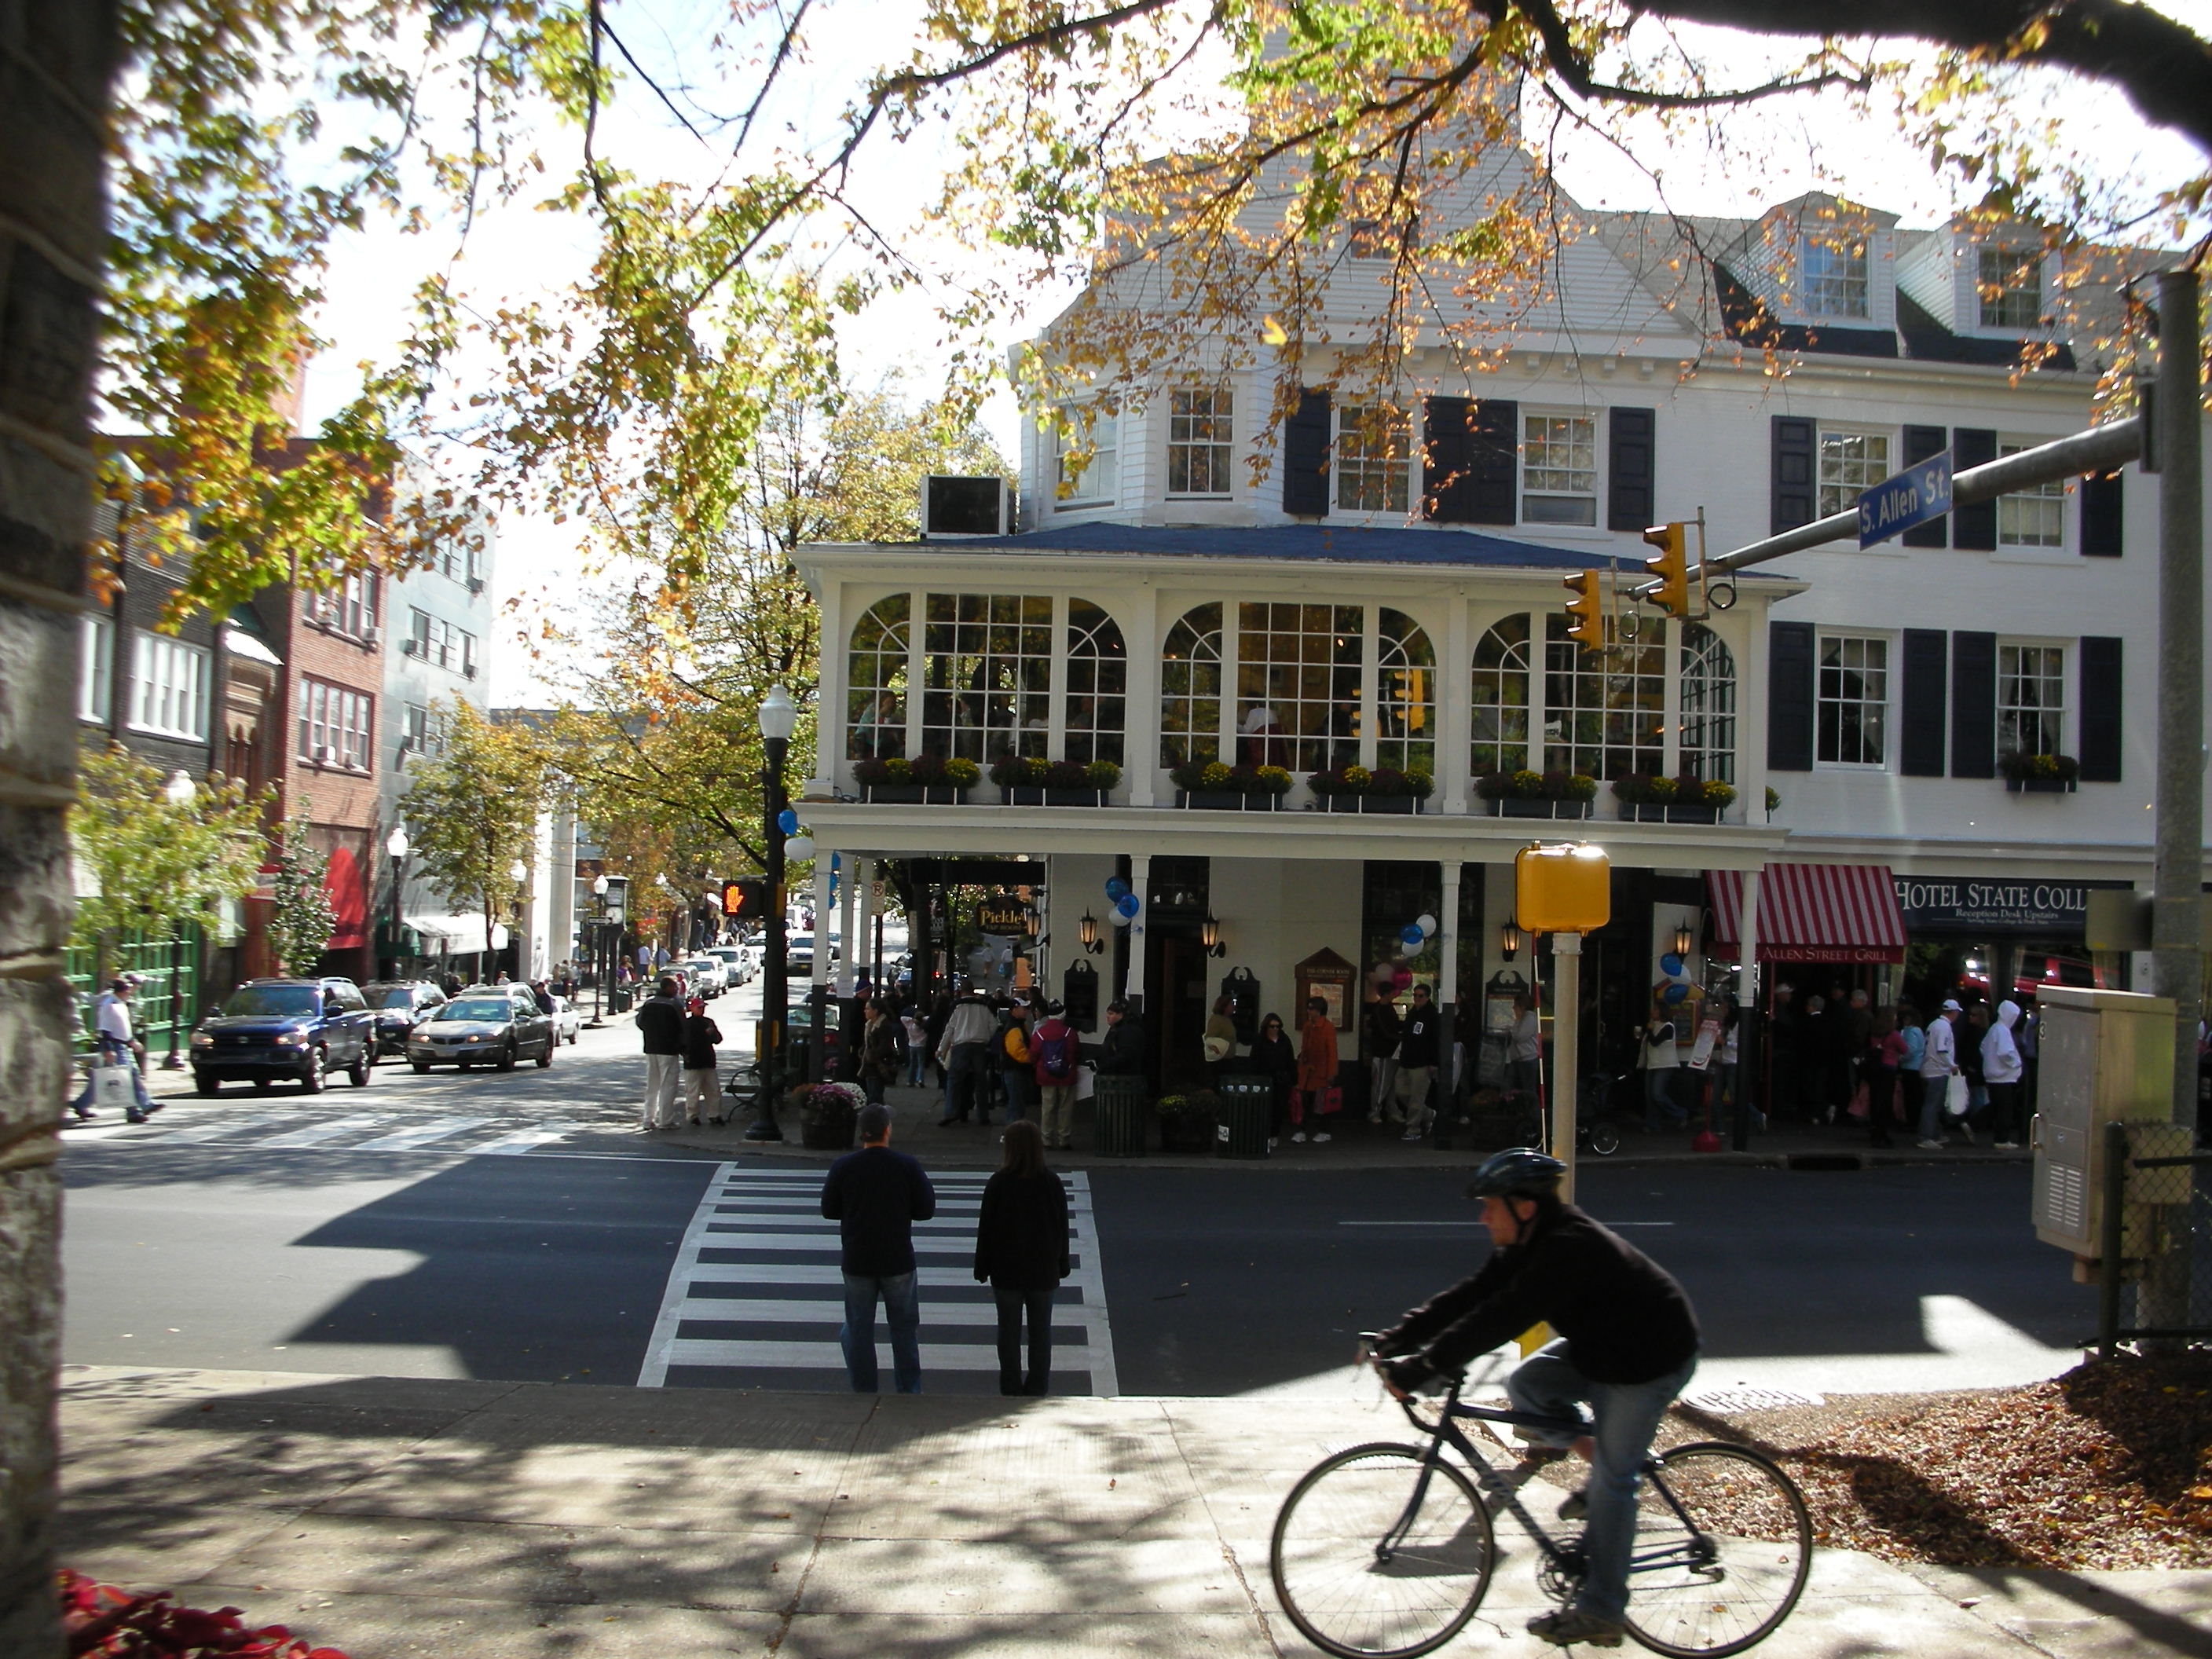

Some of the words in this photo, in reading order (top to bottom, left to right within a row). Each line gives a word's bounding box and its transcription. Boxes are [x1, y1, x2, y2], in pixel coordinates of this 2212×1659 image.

[1861, 502, 1875, 534] S.
[1879, 487, 1918, 527] Allen
[1925, 468, 1949, 505] St.
[1894, 881, 1962, 910] HOTEL
[1968, 883, 2029, 908] STATE
[2034, 884, 2092, 911] COLL
[1956, 908, 1998, 919] Reception
[2001, 909, 2021, 918] Desk
[2024, 910, 2059, 920] Upstairs
[1763, 947, 1804, 960] ALLEN
[1806, 946, 1849, 961] STREET
[1855, 948, 1889, 961] GRILL
